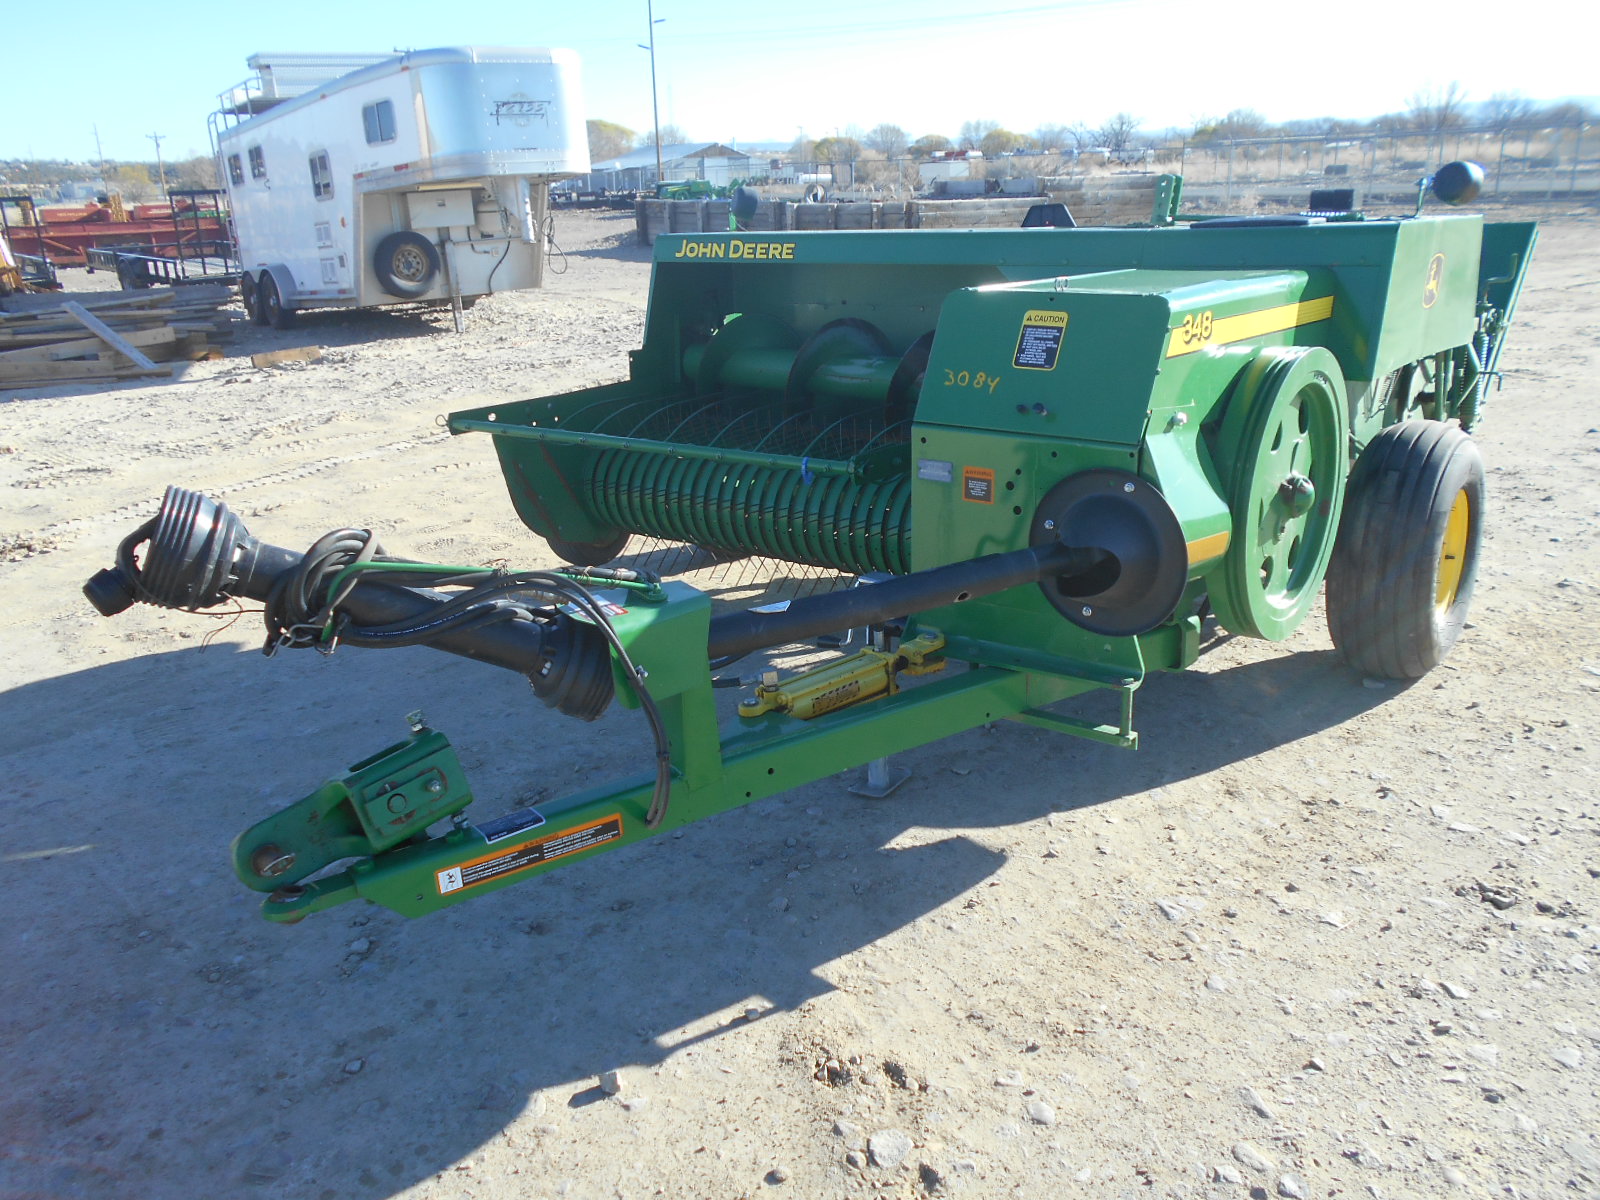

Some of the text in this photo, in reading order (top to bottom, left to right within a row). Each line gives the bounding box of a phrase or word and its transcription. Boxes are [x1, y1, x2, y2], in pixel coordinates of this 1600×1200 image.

[675, 239, 796, 260] JOHN DEERE
[1034, 314, 1065, 324] CAUTION
[1182, 310, 1213, 344] 348
[943, 368, 1000, 394] 3084
